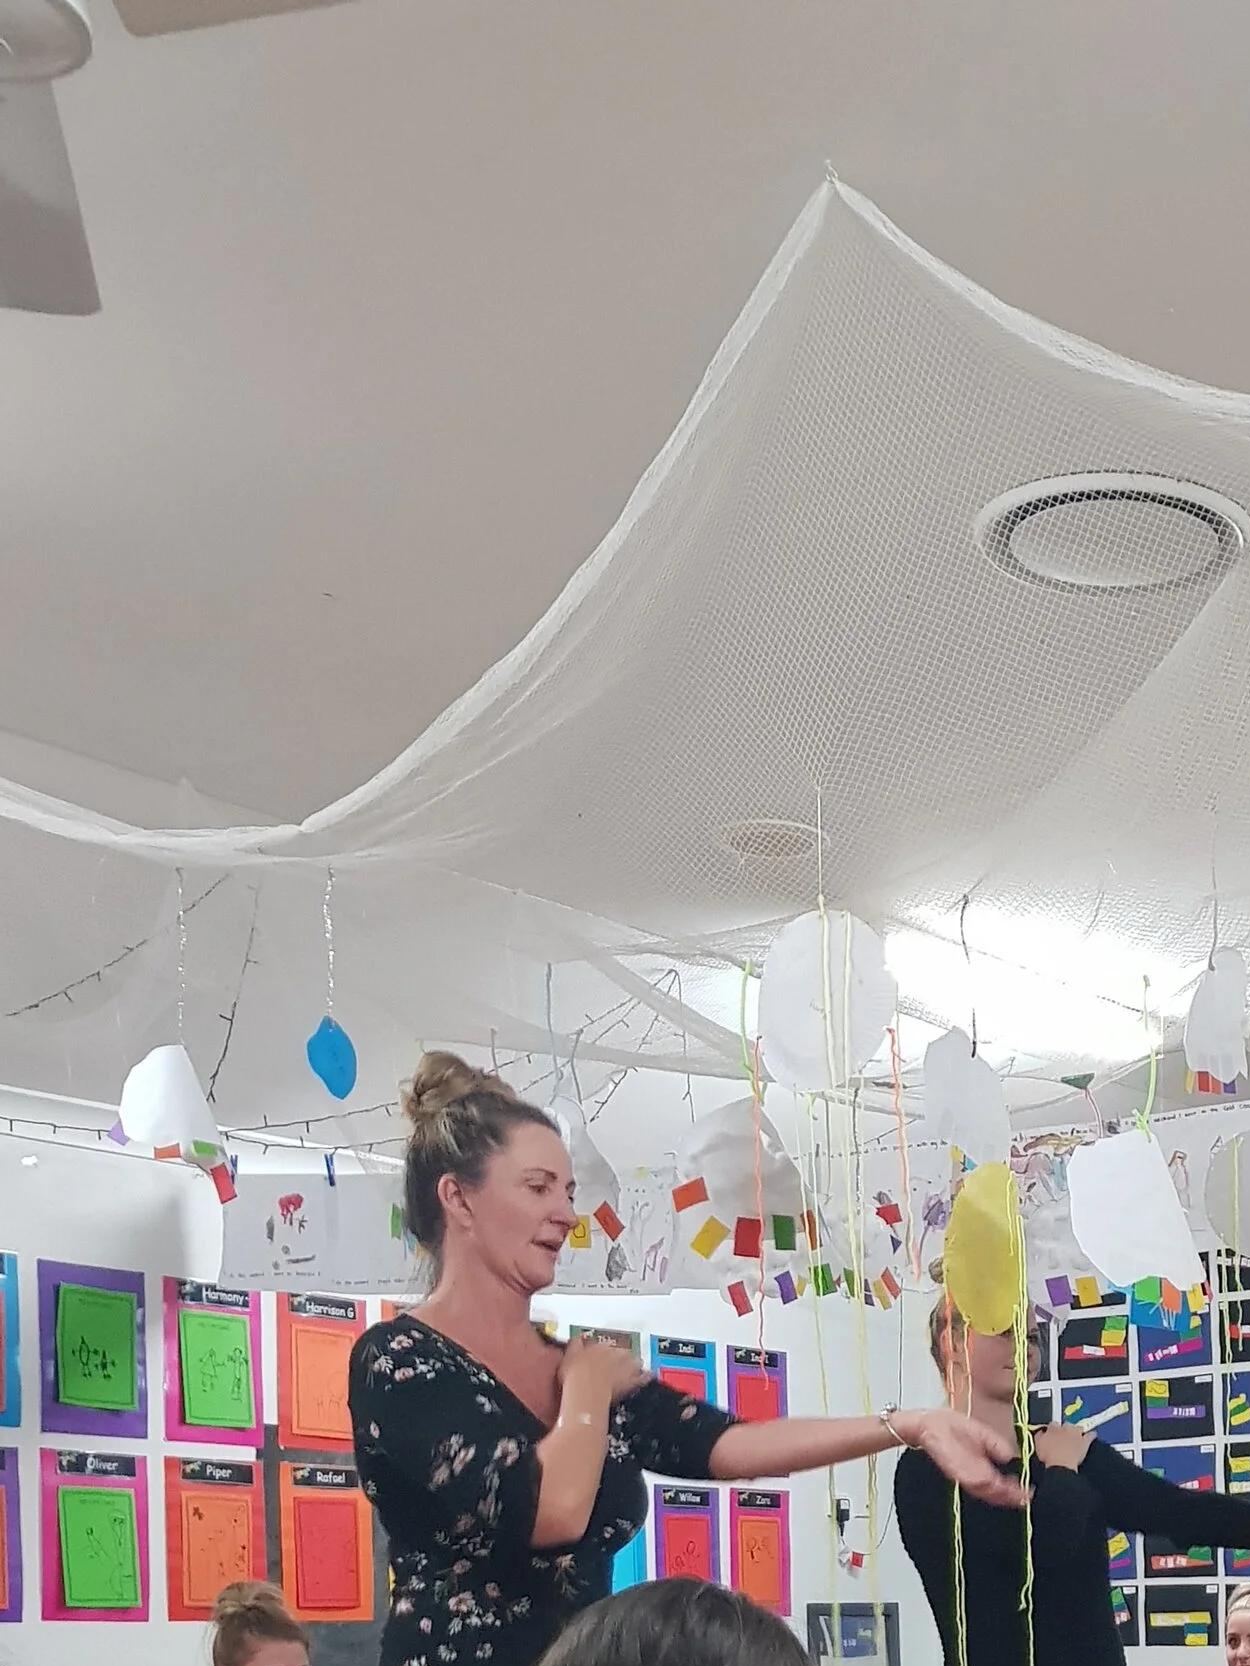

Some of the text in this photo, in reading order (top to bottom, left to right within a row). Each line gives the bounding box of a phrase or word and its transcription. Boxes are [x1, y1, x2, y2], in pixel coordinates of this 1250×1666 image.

[305, 1301, 355, 1319] Harrison G
[86, 1455, 119, 1471] Oliver
[205, 1464, 232, 1480] Piper
[316, 1470, 346, 1484] Rafael
[678, 1492, 701, 1504] Willow
